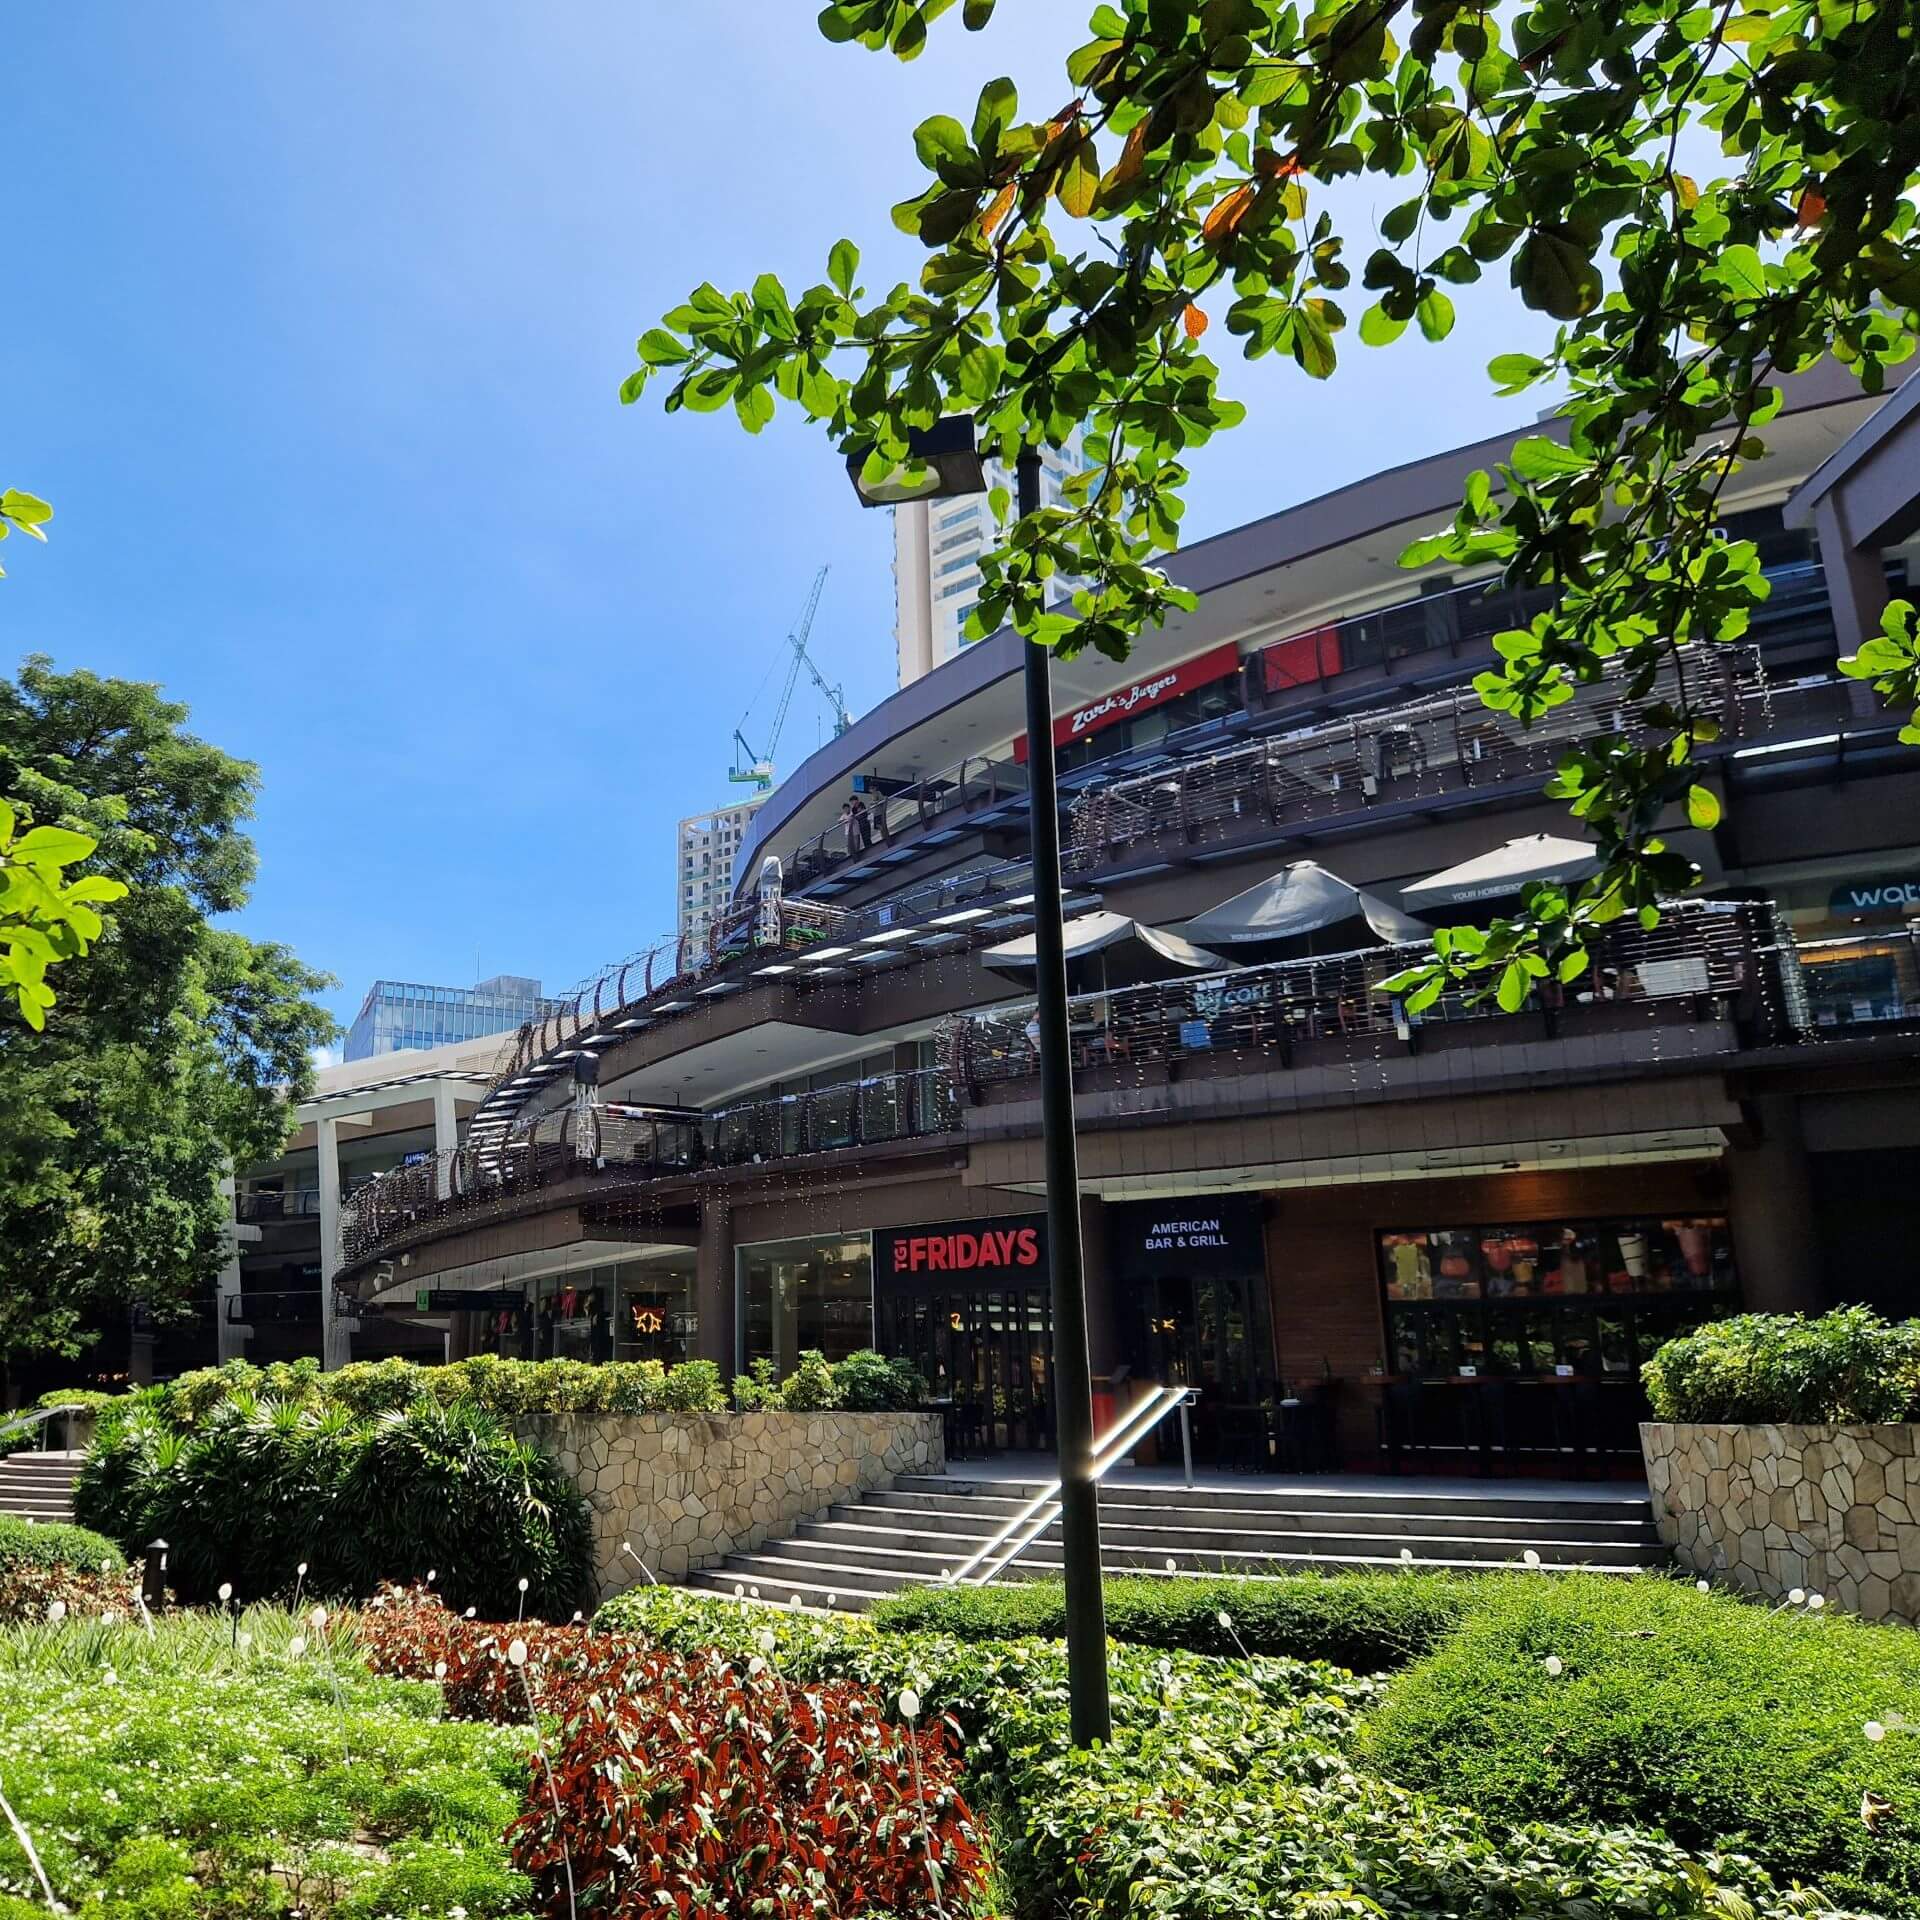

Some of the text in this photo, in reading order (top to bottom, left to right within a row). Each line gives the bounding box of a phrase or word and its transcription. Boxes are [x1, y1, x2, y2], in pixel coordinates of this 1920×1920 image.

[1071, 674, 1177, 733] Zark's Burgers
[1850, 883, 1920, 907] wat
[1151, 1219, 1219, 1234] AMERICAN
[894, 1228, 1038, 1272] TGI FRIDAYS
[1145, 1234, 1229, 1249] BAR & GRILL
